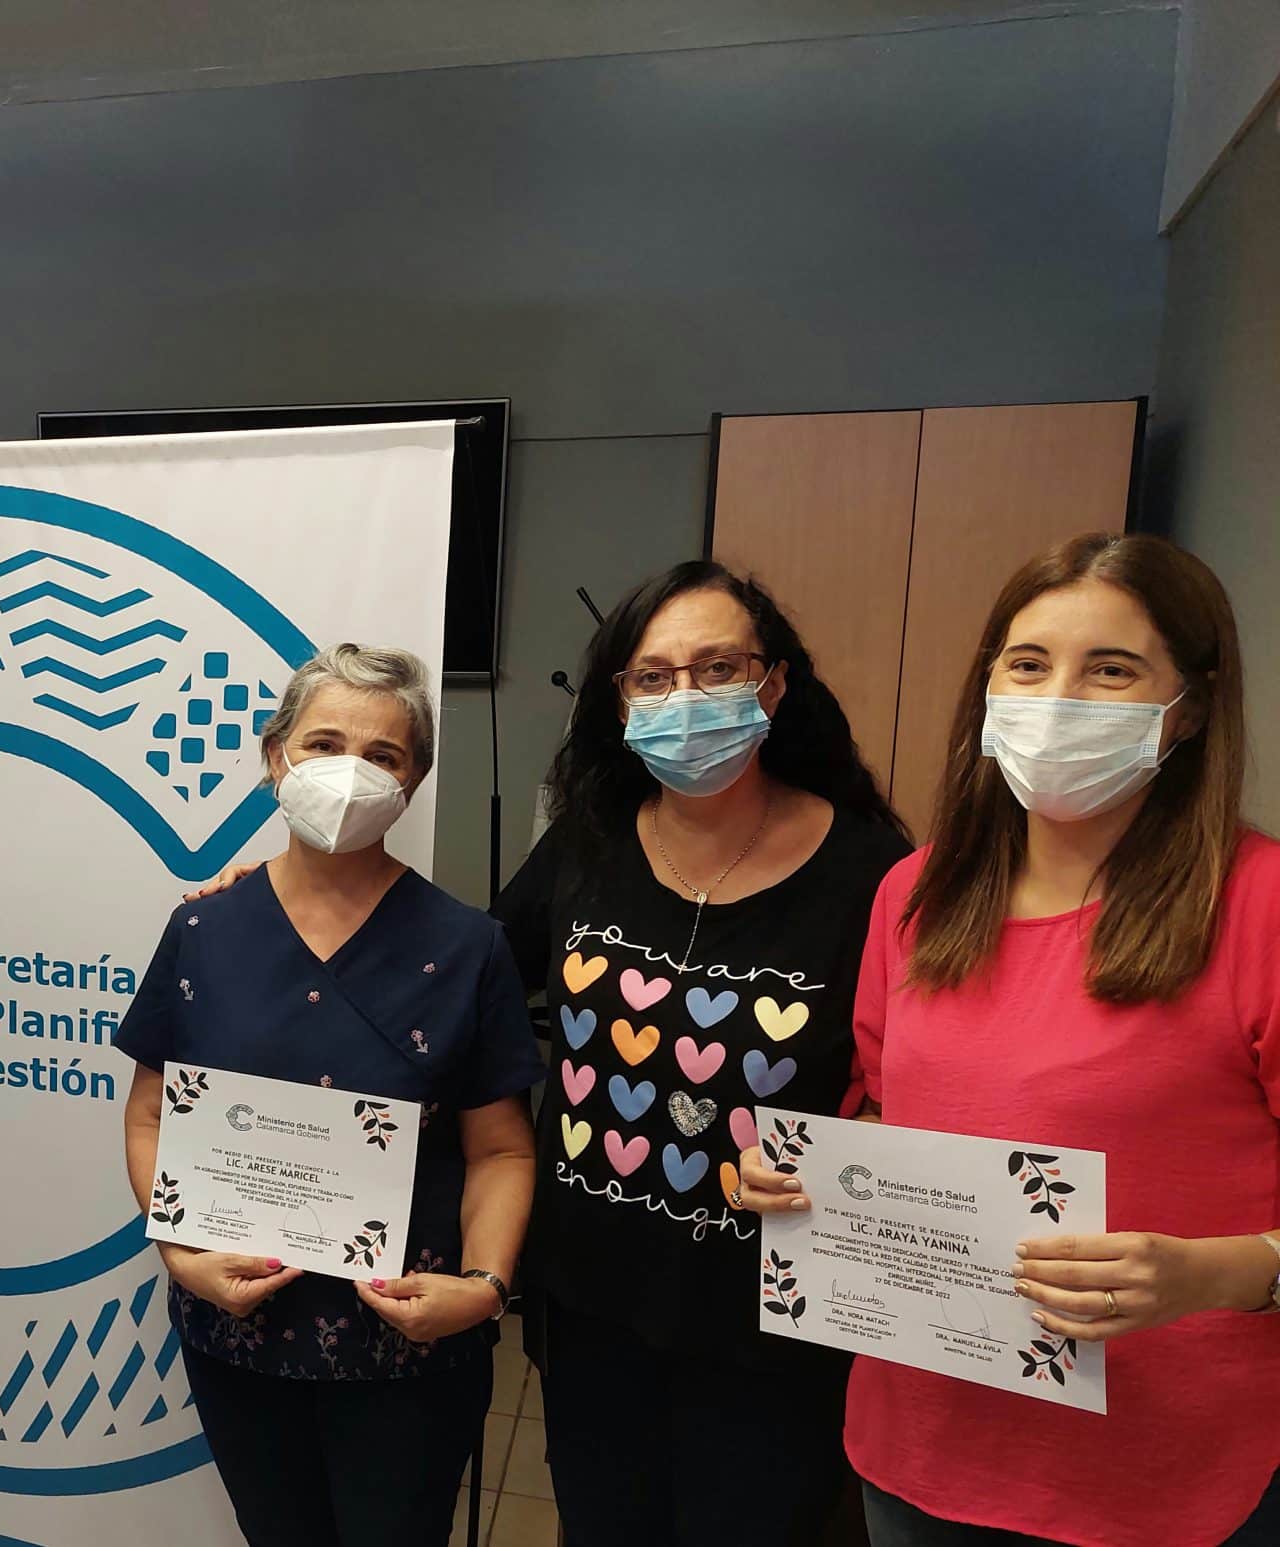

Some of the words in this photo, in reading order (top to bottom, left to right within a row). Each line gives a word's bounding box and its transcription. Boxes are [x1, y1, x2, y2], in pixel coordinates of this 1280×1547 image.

[565, 920, 703, 972] you
[707, 963, 825, 991] are
[256, 1121, 294, 1134] Catamarca
[296, 1128, 330, 1141] Gobierno
[257, 1114, 294, 1127] Ministerio
[296, 1121, 306, 1129] de
[307, 1123, 329, 1133] Salud
[226, 1157, 243, 1168] LIC.
[247, 1161, 276, 1174] ARESE
[279, 1167, 320, 1183] MARICEL
[556, 1161, 755, 1241] enough
[878, 1178, 927, 1195] Ministerio
[930, 1187, 942, 1197] de
[945, 1189, 974, 1203] Salud
[878, 1188, 928, 1205] Catamarca
[931, 1196, 977, 1214] Gobierno
[840, 1211, 861, 1220] MEDIO
[864, 1215, 876, 1223] DEL
[880, 1218, 914, 1230] PRESENTE
[930, 1228, 969, 1241] RECONOCE
[850, 1221, 872, 1235] LIC.
[877, 1226, 917, 1245] ARAYA
[921, 1235, 970, 1256] YANINA
[835, 1243, 860, 1253] MIEMBRO
[902, 1257, 927, 1268] CALIDAD
[949, 1268, 981, 1280] PROVINCIA
